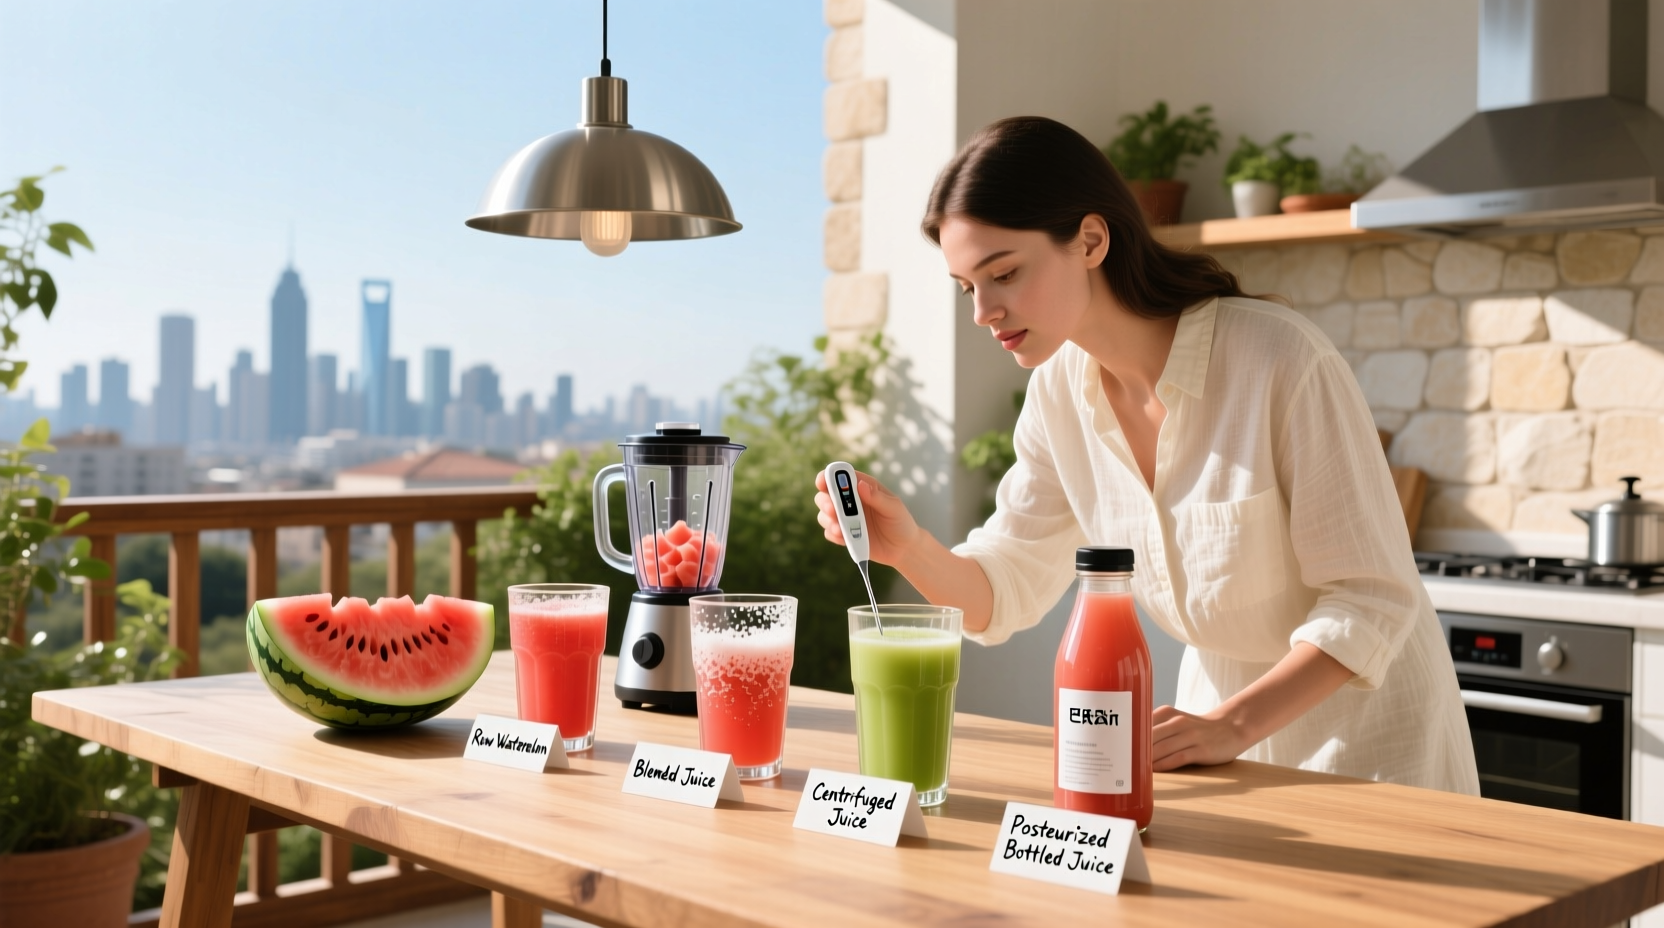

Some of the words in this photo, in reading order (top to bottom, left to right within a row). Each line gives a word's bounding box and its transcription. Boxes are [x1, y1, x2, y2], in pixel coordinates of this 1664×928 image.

[680, 767, 716, 788] Juice
[812, 782, 897, 815] Centrifuged
[827, 807, 868, 829] Juice
[1003, 838, 1065, 867] Bottled
[1067, 850, 1114, 875] Juice
